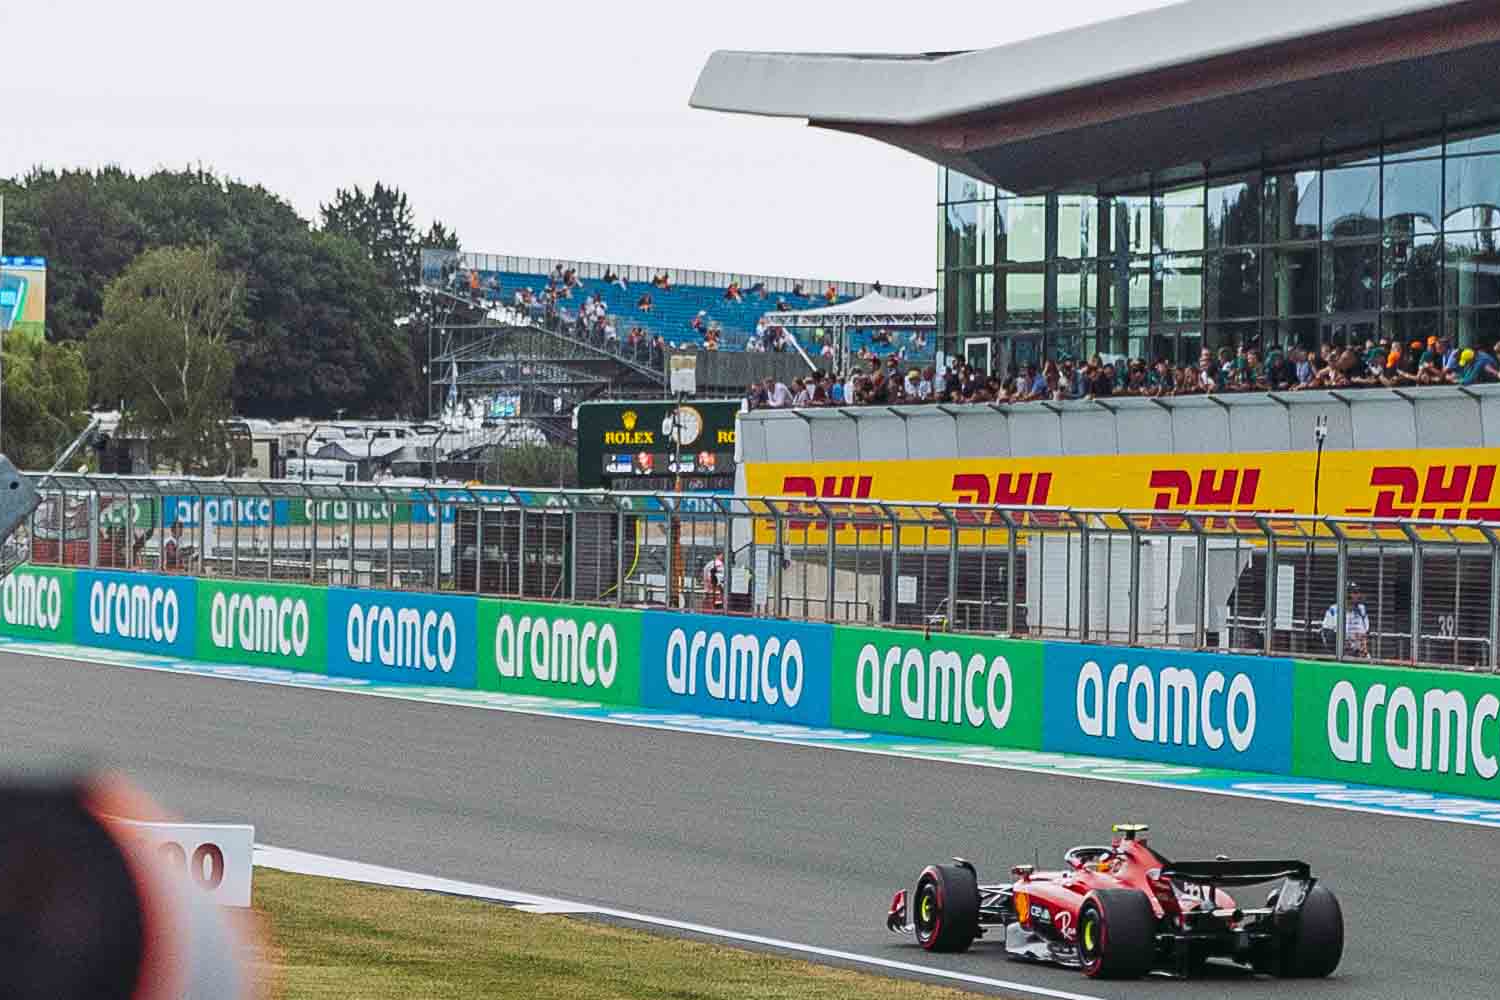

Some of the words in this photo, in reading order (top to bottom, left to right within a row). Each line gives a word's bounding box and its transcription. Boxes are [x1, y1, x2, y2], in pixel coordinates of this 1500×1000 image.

[604, 431, 654, 444] ROLEX
[783, 476, 884, 529] DHL
[952, 473, 1062, 528] DHL
[1149, 469, 1267, 529] DHL
[90, 582, 178, 642] aramco
[211, 591, 309, 657] aramco
[347, 604, 456, 671] aramco
[495, 615, 617, 688] aramco
[667, 629, 803, 706] aramco
[856, 644, 1012, 728] aramco
[1077, 661, 1256, 752] aramco
